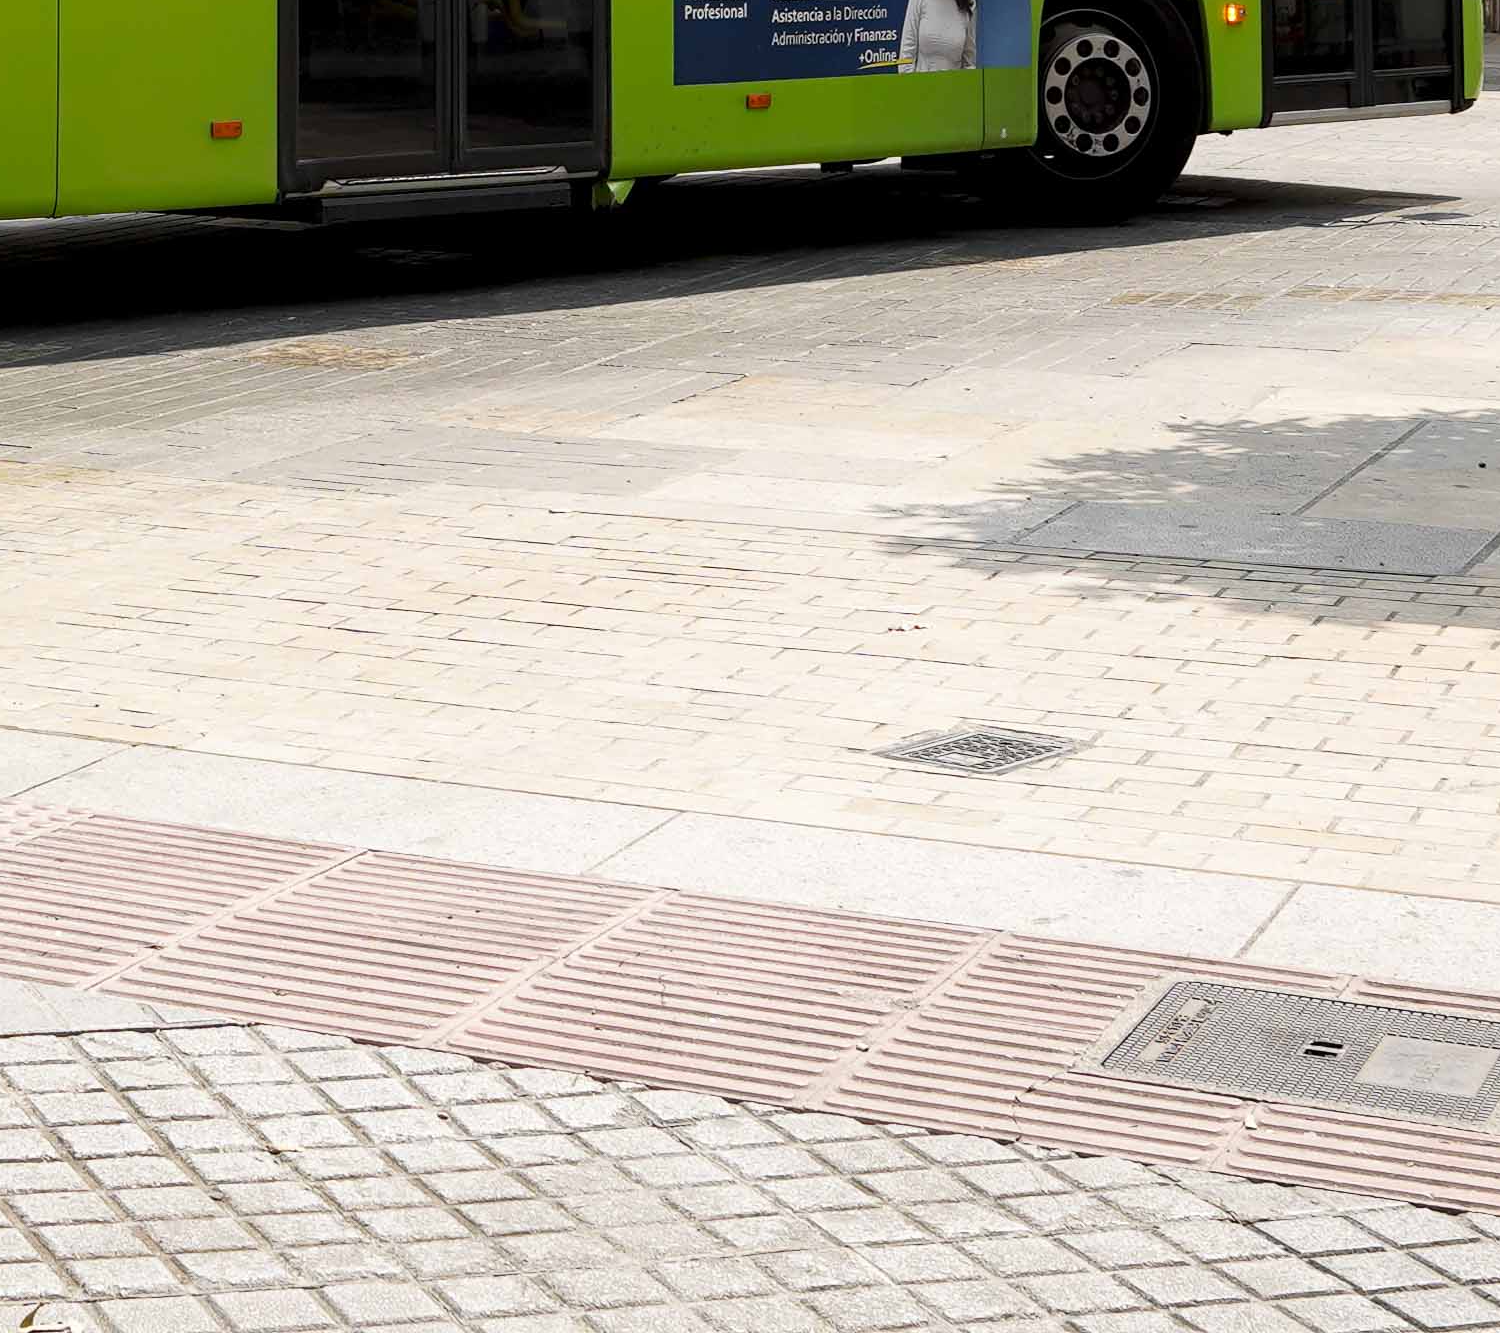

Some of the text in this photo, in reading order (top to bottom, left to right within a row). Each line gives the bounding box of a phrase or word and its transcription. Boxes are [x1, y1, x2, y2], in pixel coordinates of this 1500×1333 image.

[684, 3, 748, 20] Profesional
[771, 4, 887, 23] Asistencia a la Dirección
[771, 27, 897, 46] Administración y Finanzas
[859, 48, 897, 64] +Online
